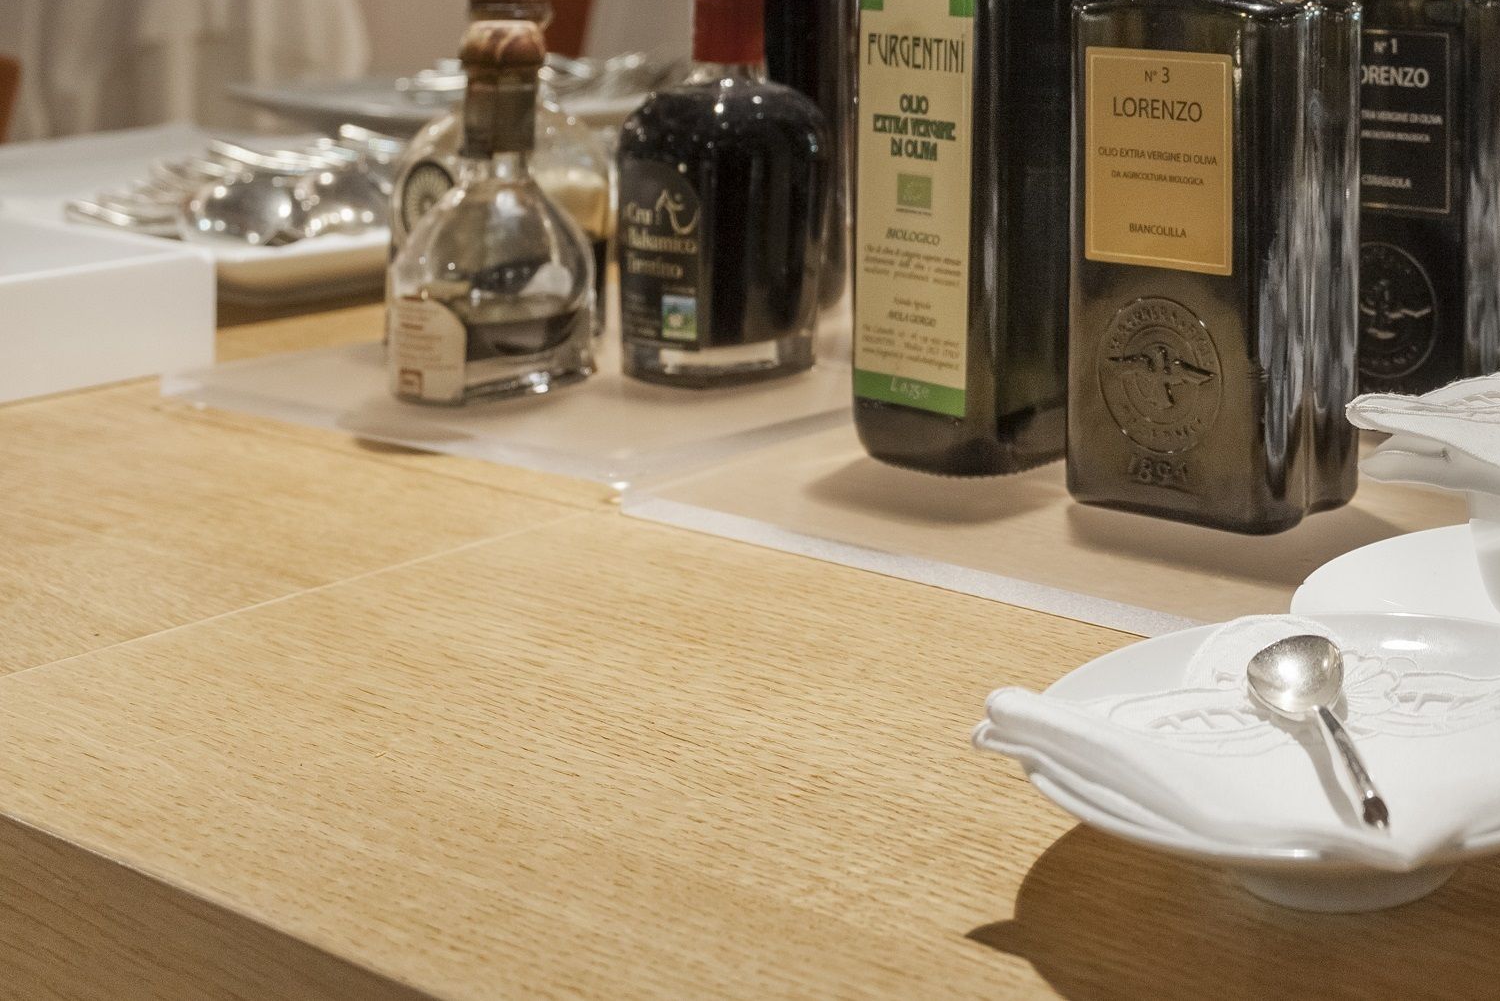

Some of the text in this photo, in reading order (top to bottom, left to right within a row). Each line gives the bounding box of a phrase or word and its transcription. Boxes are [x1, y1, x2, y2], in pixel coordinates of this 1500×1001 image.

[868, 32, 965, 74] FURGENTINI
[1391, 38, 1398, 54] 1
[1161, 66, 1170, 84] 3
[900, 94, 929, 114] OLIO
[1112, 96, 1203, 123] LORENZO
[1098, 146, 1218, 166] OLIO EXTRA VERGINE DI OLIVA
[886, 227, 941, 247] BIOLOGICO
[1129, 223, 1187, 238] BIANCOLILLA
